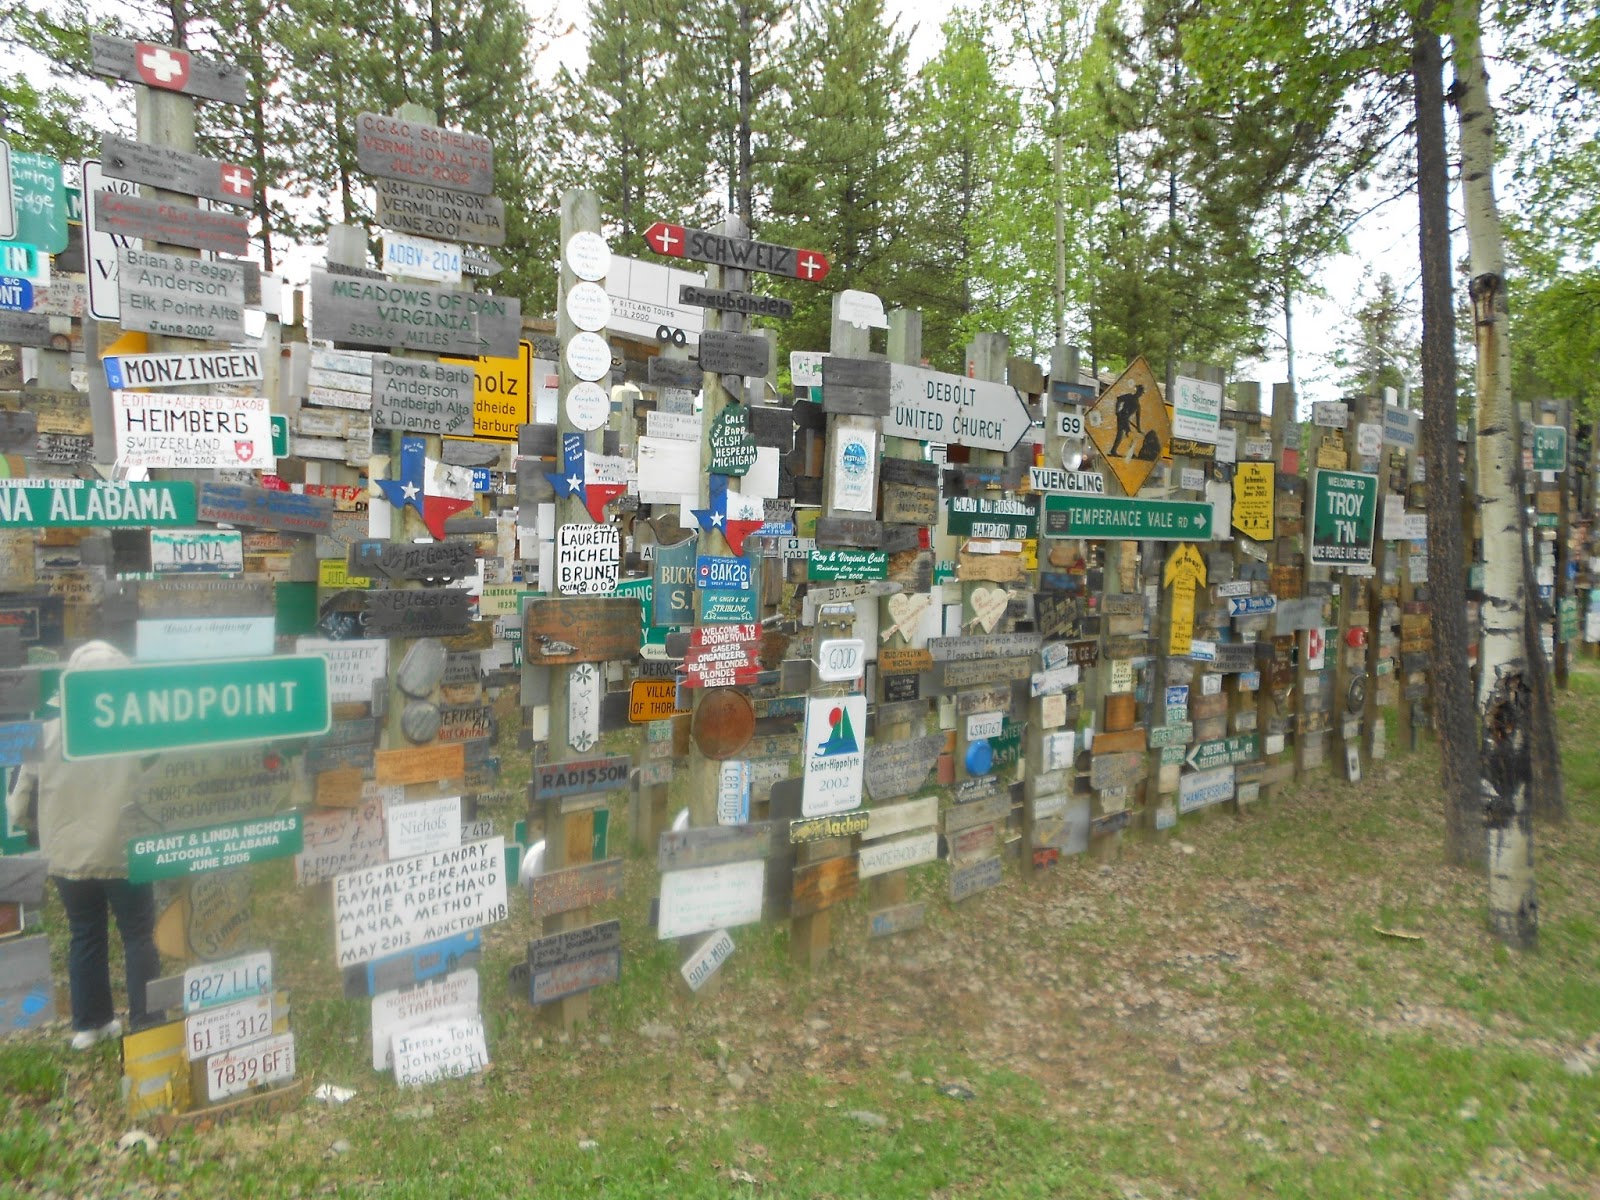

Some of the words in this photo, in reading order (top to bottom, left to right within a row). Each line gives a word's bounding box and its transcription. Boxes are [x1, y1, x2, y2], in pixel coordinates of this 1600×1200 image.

[421, 129, 489, 153] SCHIELKE
[364, 136, 445, 163] VERMILION
[451, 154, 488, 170] ALTA
[390, 162, 427, 177] JULY
[432, 166, 470, 185] 2002
[417, 189, 485, 210] JOHNSON
[382, 197, 461, 220] VERMILION
[466, 212, 500, 228] ALTA
[382, 213, 422, 231] JUNE
[425, 219, 460, 235] 2001
[691, 232, 792, 273] SCHWEIZ
[127, 251, 167, 269] Brian
[175, 259, 184, 271] &
[190, 261, 236, 282] Peggy
[138, 270, 227, 296] Anderson
[131, 294, 158, 310] Elk
[162, 299, 205, 317] Point
[210, 305, 239, 321] Alta
[332, 281, 434, 306] MEADOWS
[438, 295, 460, 311] OF
[467, 298, 506, 316] DAN
[378, 306, 471, 330] VIRGINIA
[620, 300, 651, 313] RITLAND
[654, 308, 674, 318] TOURS
[631, 312, 650, 321] 2000
[150, 321, 183, 333] June
[187, 324, 215, 336] 2002
[406, 329, 450, 346] MILES
[125, 355, 258, 383] MONZINGEN
[383, 361, 416, 377] Don
[419, 364, 432, 378] &
[435, 367, 469, 384] Barb
[386, 378, 458, 399] Anderson
[927, 381, 976, 407] DEBOLT
[382, 395, 443, 414] Lindbergh
[1192, 394, 1218, 407] Skinner
[127, 408, 248, 433] HEIMBERG
[375, 411, 386, 425] &
[391, 410, 440, 428] Dianne
[445, 414, 466, 432] 2002
[725, 414, 745, 424] GALE
[896, 407, 943, 431] UNITED
[952, 416, 1002, 440] CHURCH
[1062, 417, 1081, 433] 69
[714, 424, 723, 438] AND
[724, 426, 746, 436] BARB
[126, 437, 220, 450] SWITZERLAND
[712, 436, 740, 447] WELSH
[713, 454, 756, 467] MICHIGAN
[716, 446, 755, 457] HESPERIA
[1032, 470, 1103, 493] YUENGLING
[1328, 476, 1354, 489] WELCOME
[1357, 479, 1365, 490] TO
[305, 484, 361, 500] BETTY
[51, 488, 177, 521] ALABAMA
[955, 497, 976, 511] CLAY
[1327, 491, 1364, 516] TROY
[1069, 507, 1144, 527] TEMPERANCE
[1148, 511, 1173, 527] VALE
[1178, 517, 1188, 528] RD
[562, 531, 619, 546] LAURETTE
[973, 524, 1009, 537] HAMPTON
[1016, 526, 1026, 537] NB
[173, 542, 223, 561] NONA
[812, 551, 827, 563] Roy
[829, 552, 836, 561] &
[838, 552, 866, 564] Virginia
[868, 552, 885, 563] Cash
[1313, 546, 1326, 558] NICE
[1327, 546, 1345, 559] PEOPLE
[1346, 547, 1357, 560] LIVE
[1358, 548, 1372, 560] HERE
[562, 564, 619, 582] BRUNET
[711, 564, 747, 582] 8AK26
[712, 604, 746, 613] STRIBLING
[701, 625, 739, 636] WELCOME
[744, 624, 755, 632] TO
[701, 632, 756, 645] BOOMERVILLE
[698, 651, 746, 663] ORGANIZERS
[711, 644, 740, 653] GASERS
[688, 662, 710, 673] REAL
[715, 659, 748, 670] BLONDES
[700, 669, 735, 680] BLONDES
[704, 678, 735, 688] DIESELS
[95, 682, 298, 728] SANDPOINT
[633, 702, 644, 714] OF
[1230, 740, 1238, 750] VIA
[811, 756, 859, 772] Saint-Hippolyte
[1200, 754, 1229, 768] TELEGRAPH
[542, 764, 628, 788] RADISSON
[819, 776, 849, 791] 2002
[1183, 781, 1232, 807] CHAMBERSBURG
[825, 816, 868, 834] Aachen
[135, 836, 184, 854] GRANT
[189, 833, 198, 846] &
[203, 827, 239, 844] LINDA
[244, 818, 296, 837] NICHOLS
[156, 846, 212, 865] ALTOONA
[224, 835, 279, 852] ALABAMA
[190, 857, 219, 871] JUNE
[223, 853, 250, 866] 2006
[385, 860, 423, 878] ROSE
[433, 844, 488, 867] LANDRY
[338, 885, 402, 907] RAYNAL
[462, 856, 497, 875] AUBE
[340, 899, 393, 922] MARIE
[415, 893, 483, 921] METHOT
[341, 943, 376, 961] MAY
[382, 933, 411, 949] 2013
[424, 912, 483, 939] MONCTON
[488, 904, 507, 922] NB
[190, 974, 224, 1002] 827
[233, 966, 267, 992] LLC
[399, 993, 458, 1019] STARNES
[193, 1029, 213, 1052] 61
[237, 1013, 268, 1039] 312
[214, 1057, 257, 1088] 7839
[263, 1049, 282, 1073] GF
